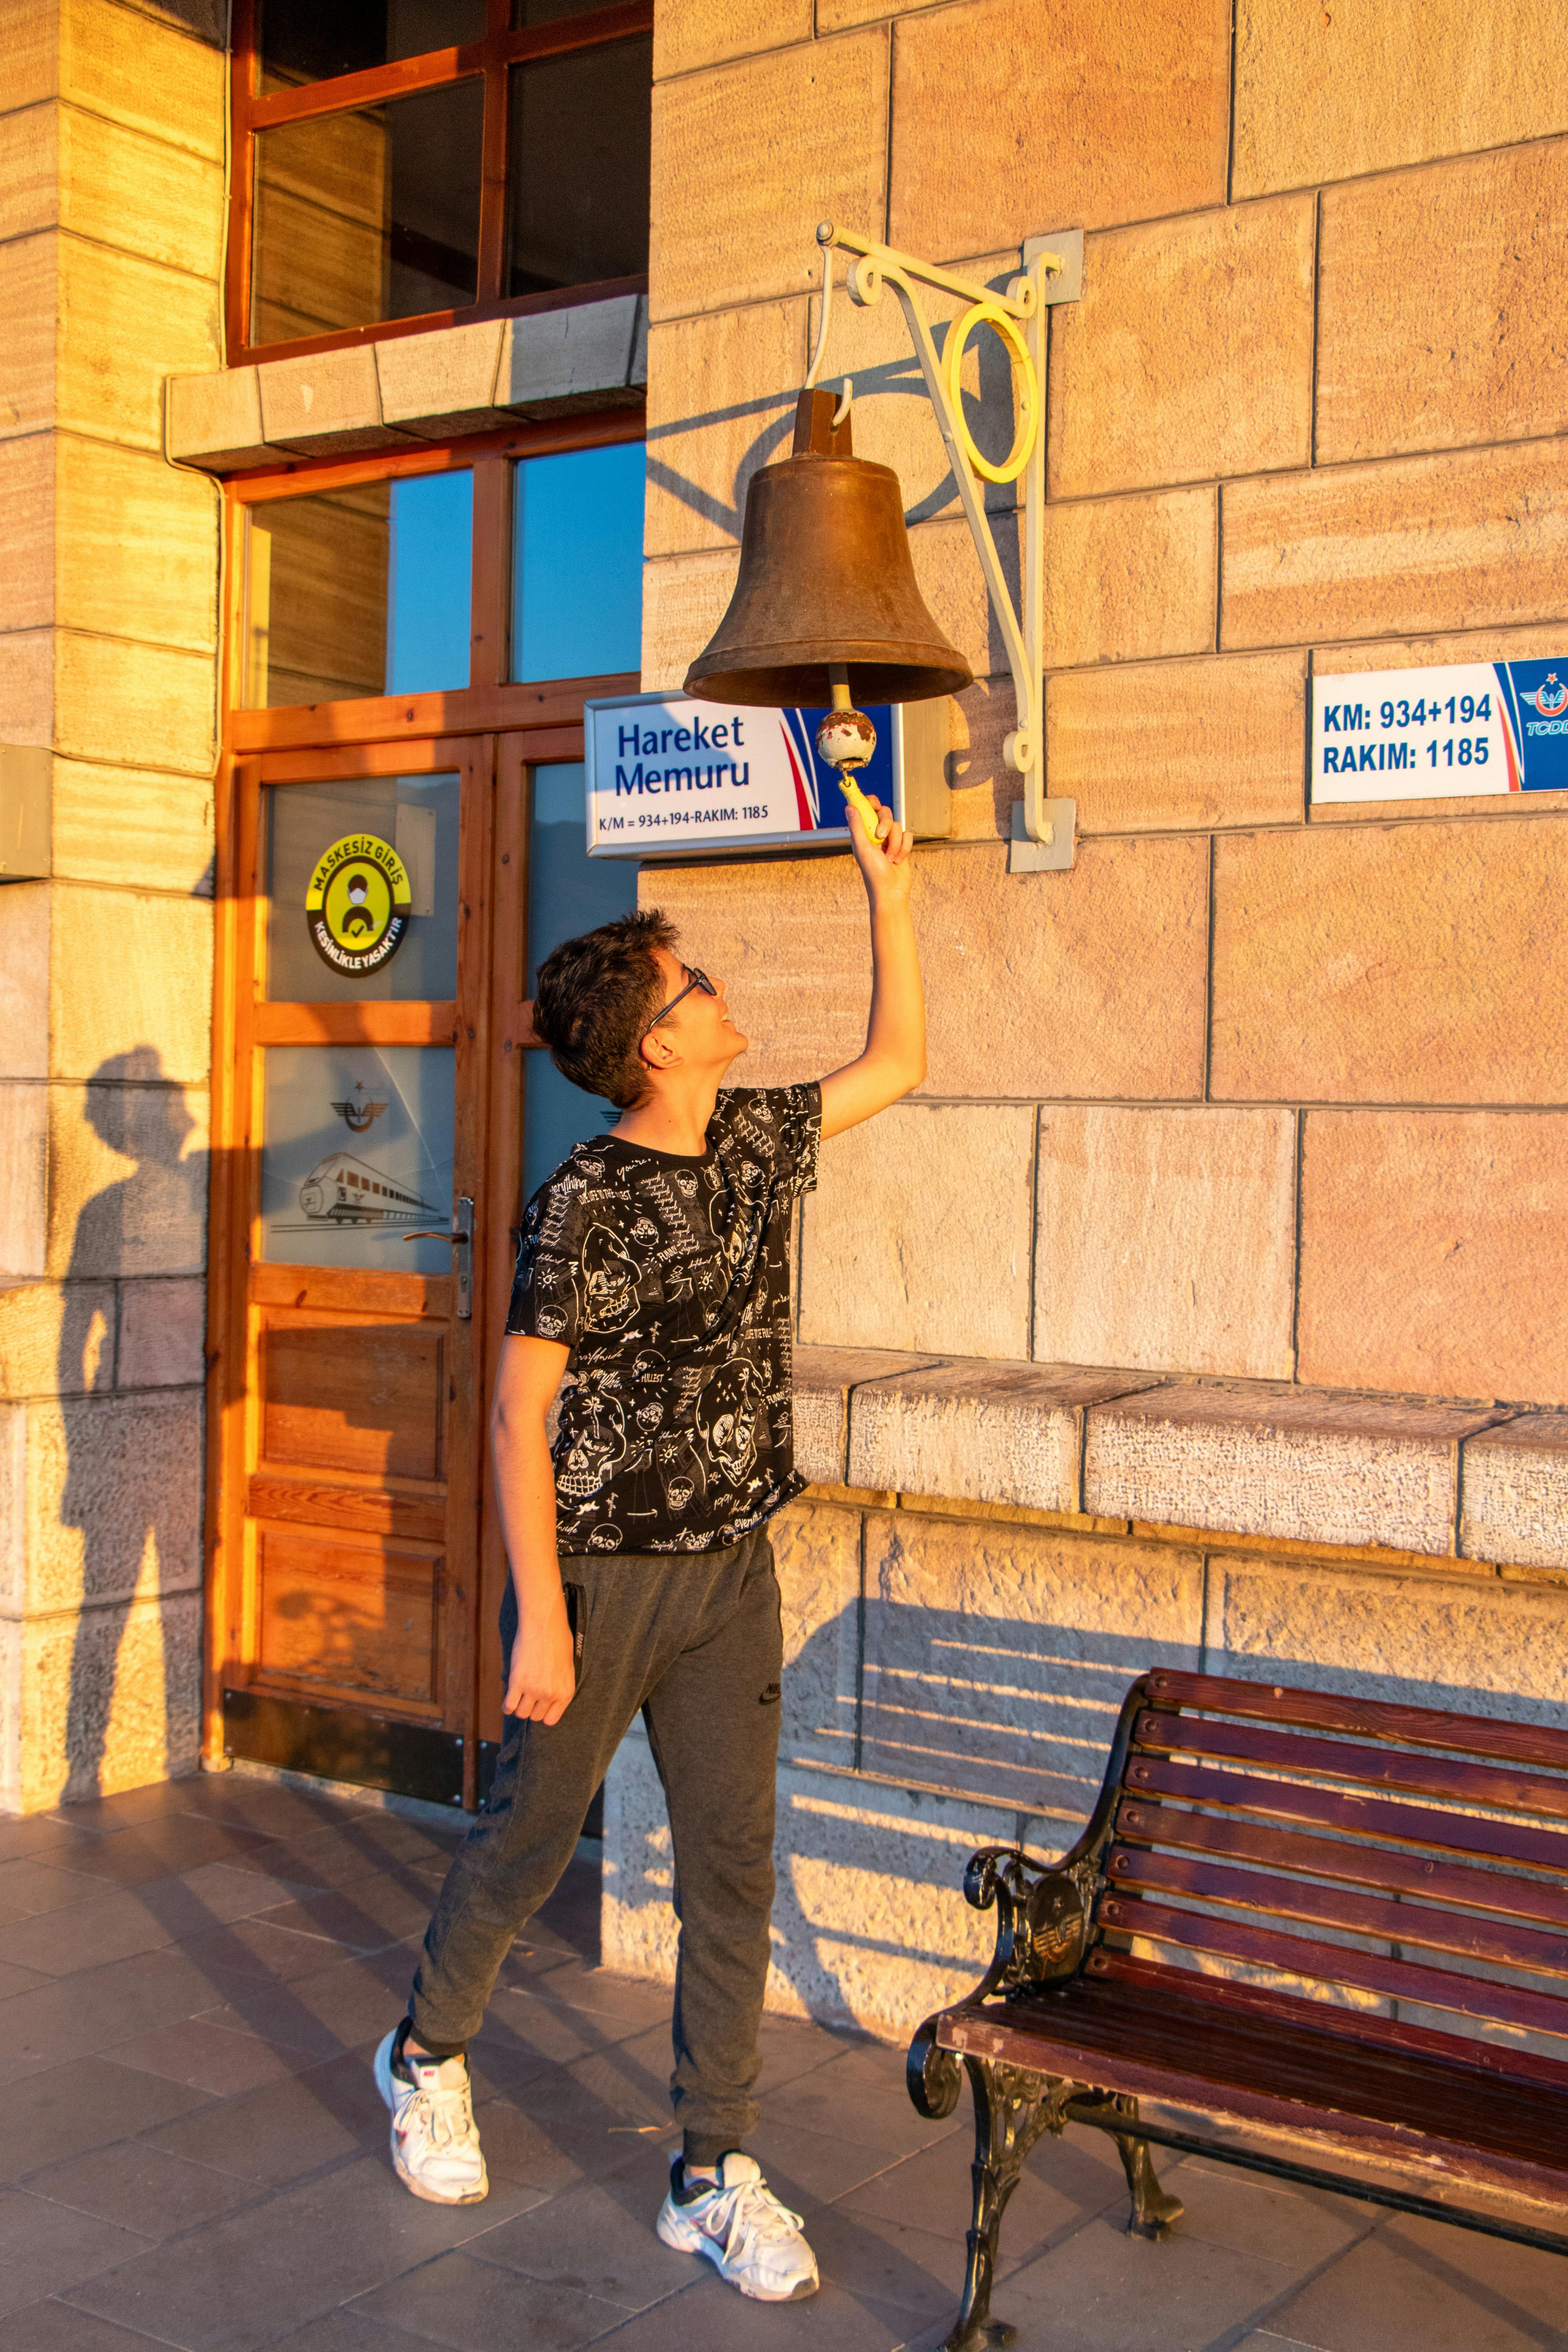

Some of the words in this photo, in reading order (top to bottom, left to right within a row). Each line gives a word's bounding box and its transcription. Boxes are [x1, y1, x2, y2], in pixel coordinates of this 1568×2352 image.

[1324, 704, 1370, 732] KM:
[1380, 693, 1491, 729] 934+194
[618, 716, 744, 758] Hareket
[1323, 742, 1416, 773] RAKIM:
[1426, 737, 1488, 768] 1185
[615, 761, 750, 797] Memuru
[599, 817, 624, 831] K/M
[742, 806, 768, 820] 1185
[314, 837, 373, 891] MASKESİZ
[375, 846, 403, 885] GİRİŞ
[550, 1174, 588, 1196] verything
